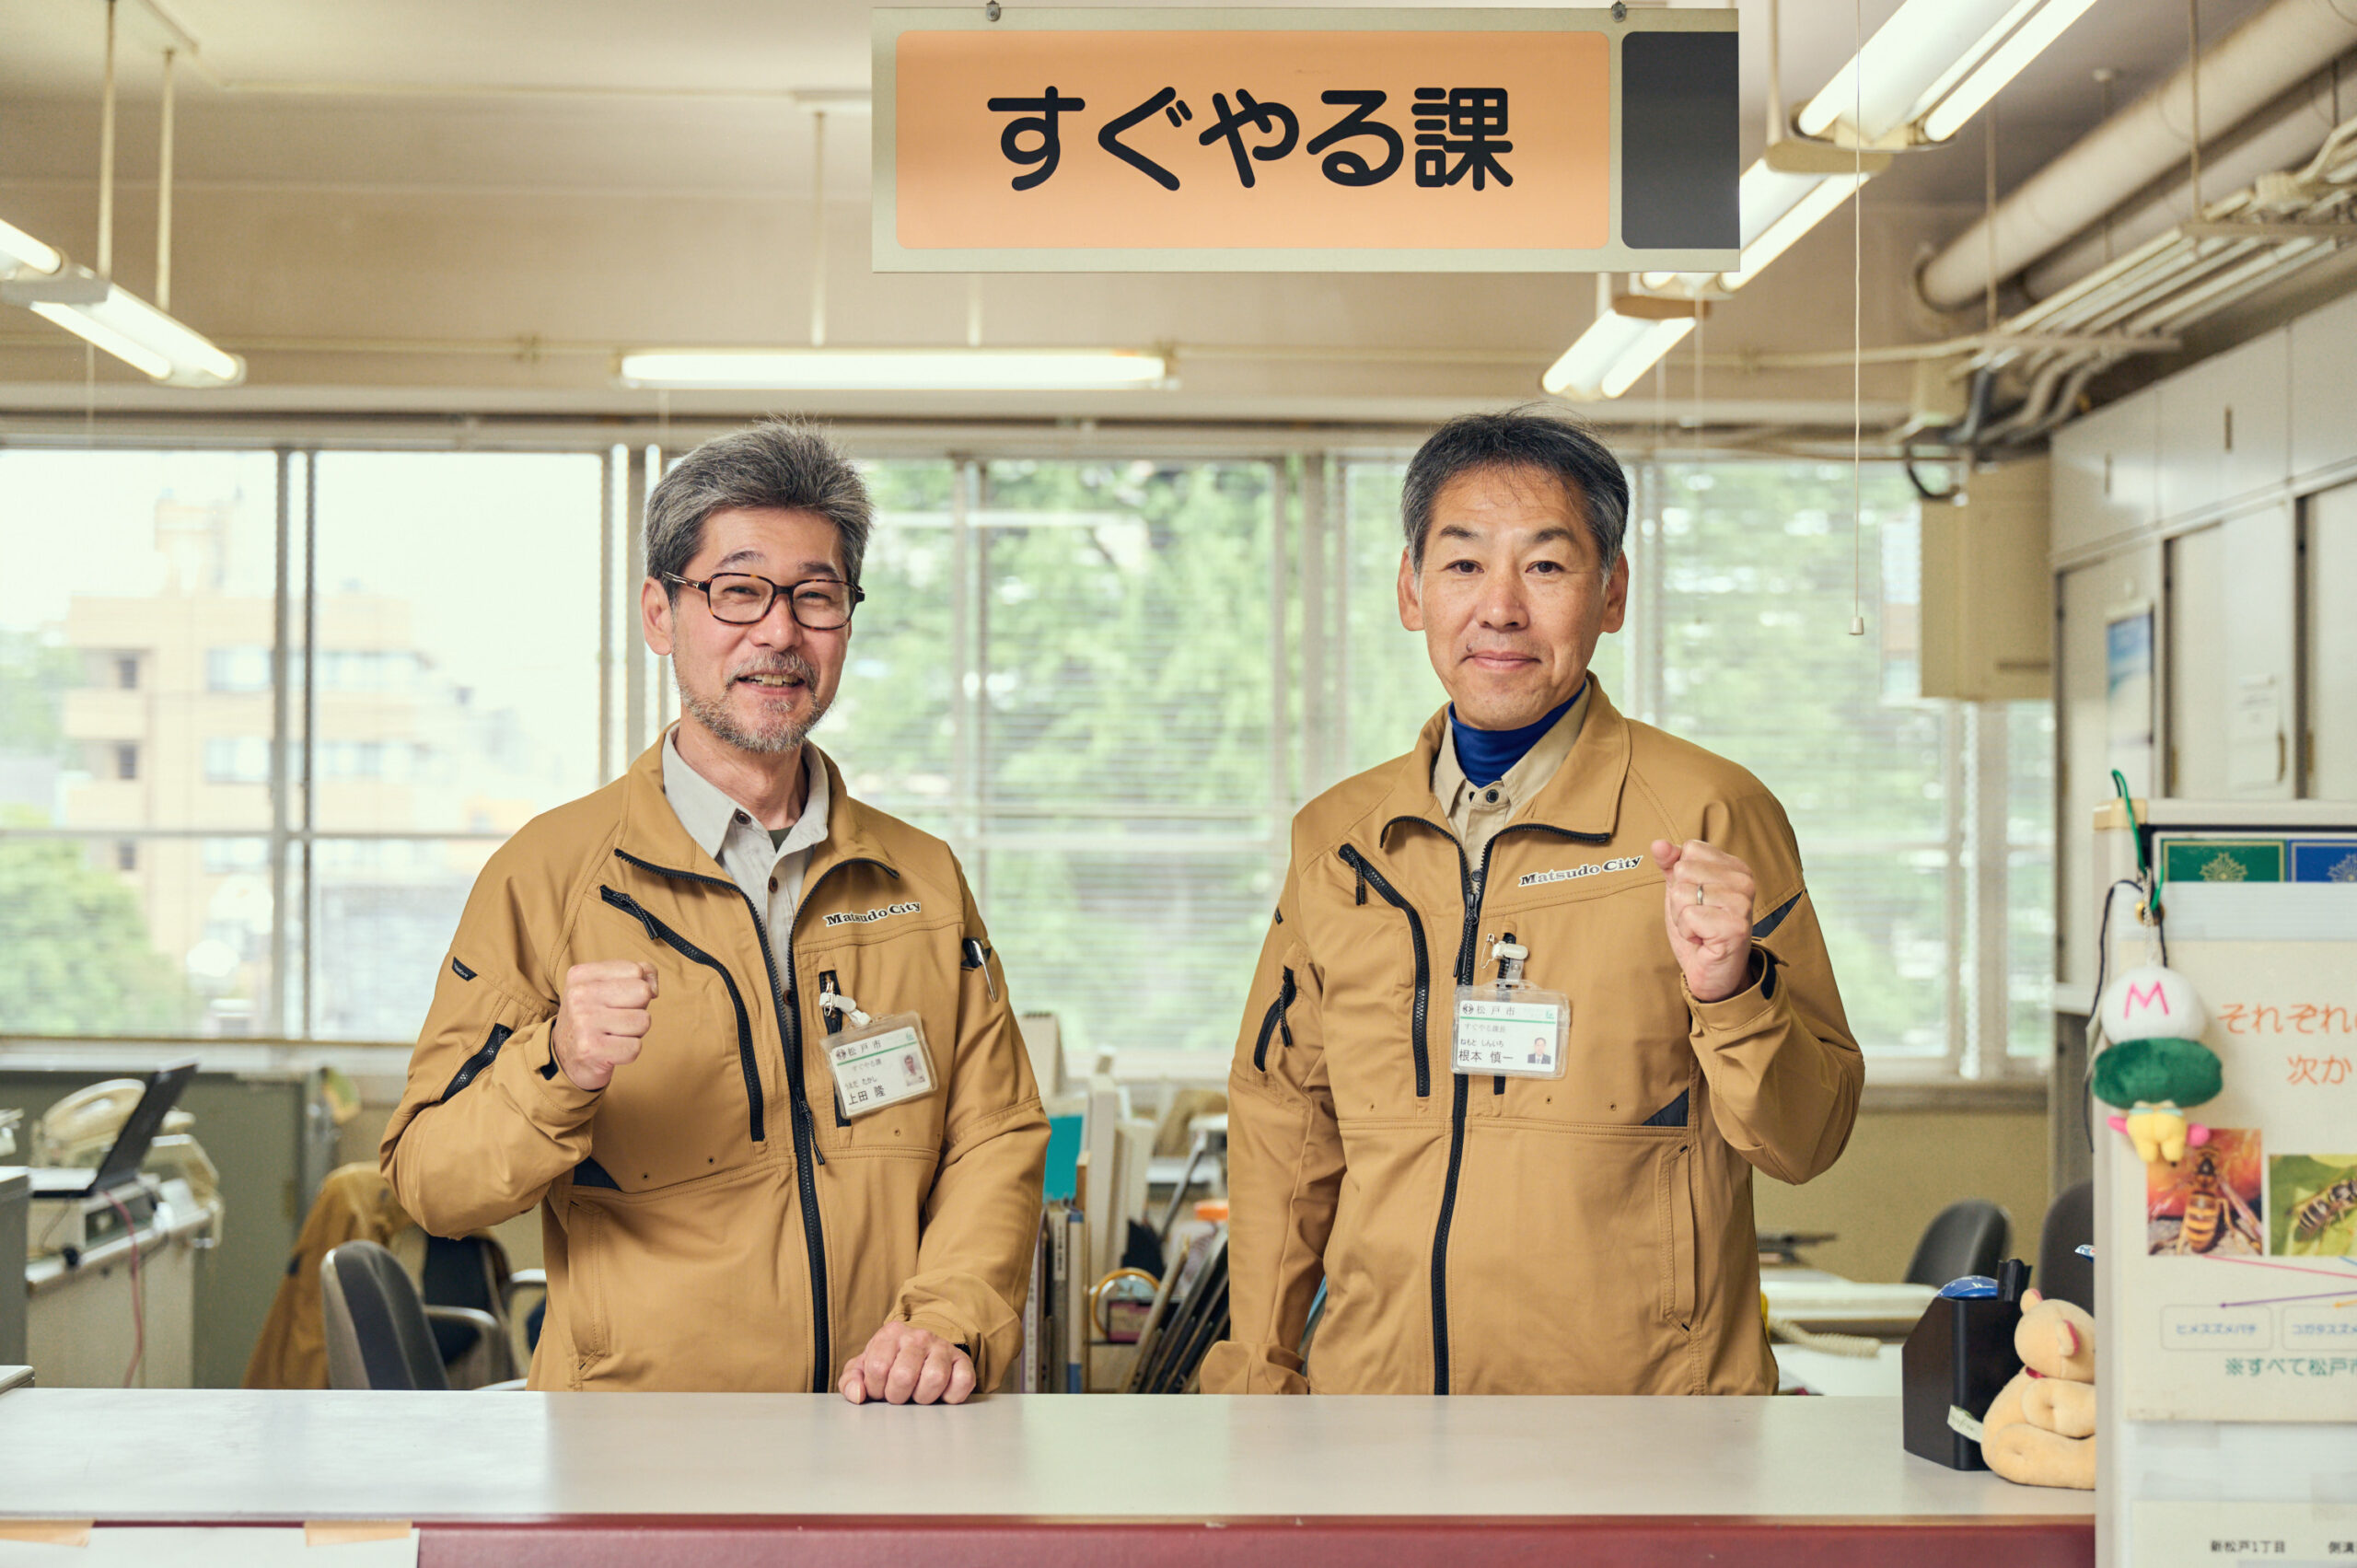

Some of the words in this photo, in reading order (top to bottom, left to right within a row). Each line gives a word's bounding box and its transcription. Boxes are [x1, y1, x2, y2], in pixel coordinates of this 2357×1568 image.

[987, 86, 1514, 192] すぐやる課
[1520, 864, 1601, 886] Matsudo
[1602, 855, 1643, 873] City
[825, 907, 888, 926] Matsudo
[888, 901, 922, 914] City
[1476, 1005, 1516, 1016] 松戸市
[2124, 981, 2169, 1019] M
[2217, 1003, 2357, 1034] それぞれ
[847, 1039, 883, 1056] 松戸市
[1458, 1049, 1482, 1063] 根本
[1490, 1050, 1514, 1063] 慎一
[848, 1090, 869, 1106] 上田
